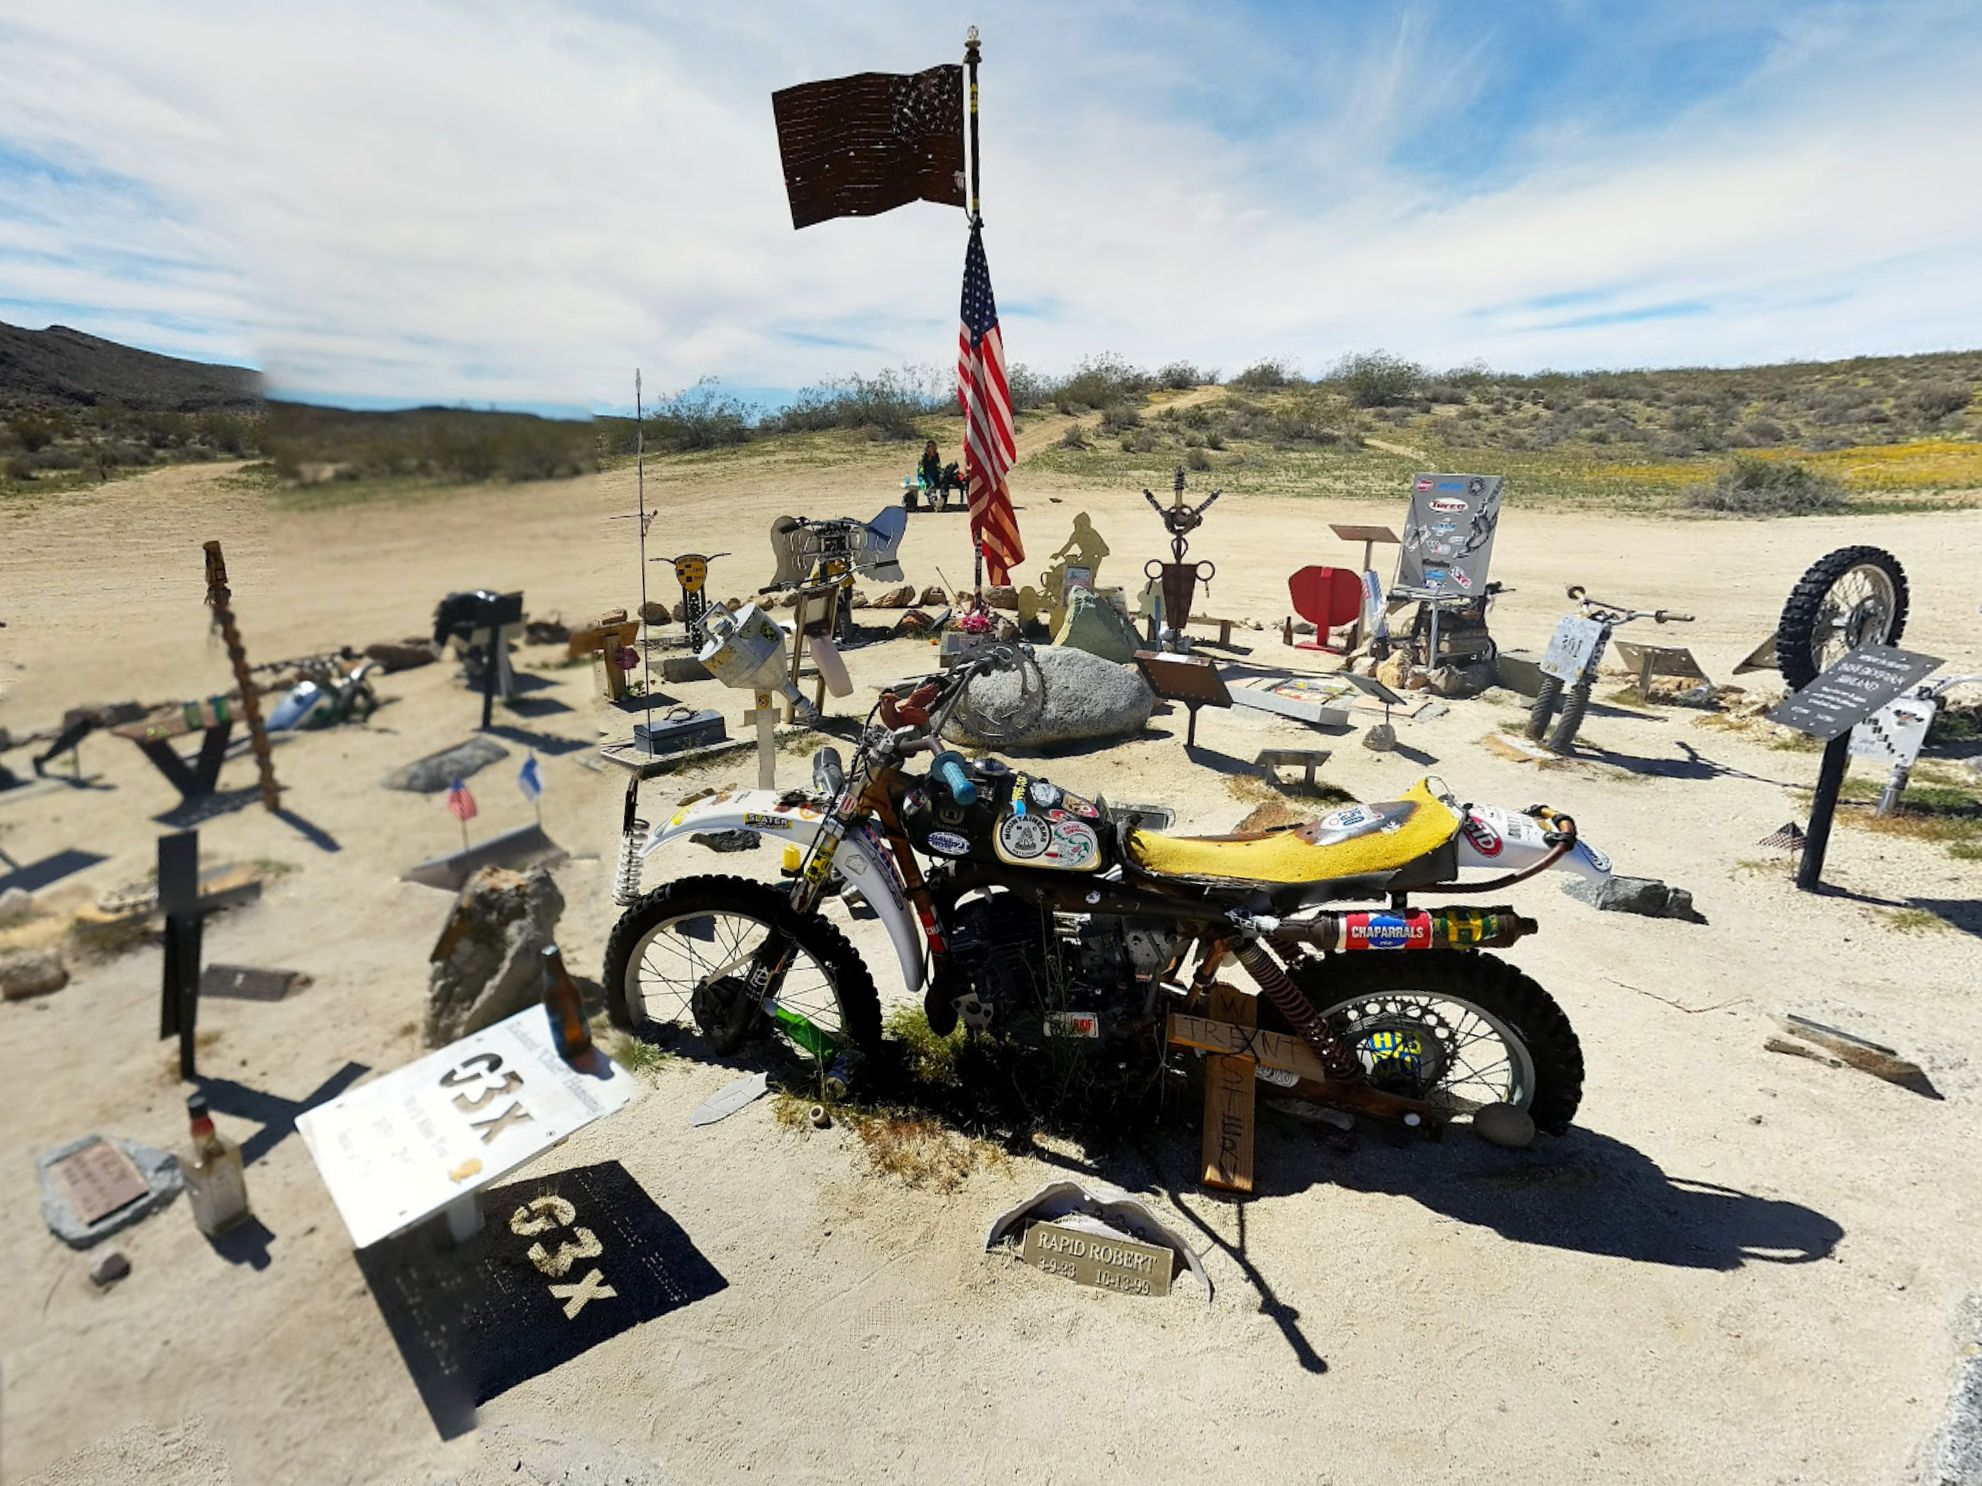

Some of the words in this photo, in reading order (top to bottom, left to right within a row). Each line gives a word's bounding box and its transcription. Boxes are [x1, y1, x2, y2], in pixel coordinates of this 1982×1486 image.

[748, 813, 788, 826] SLATER
[1351, 925, 1424, 939] CHAPARRALS
[1182, 1015, 1298, 1064] TRENT
[1037, 1231, 1087, 1258] RAPID
[1088, 1242, 1158, 1275] ROBERT
